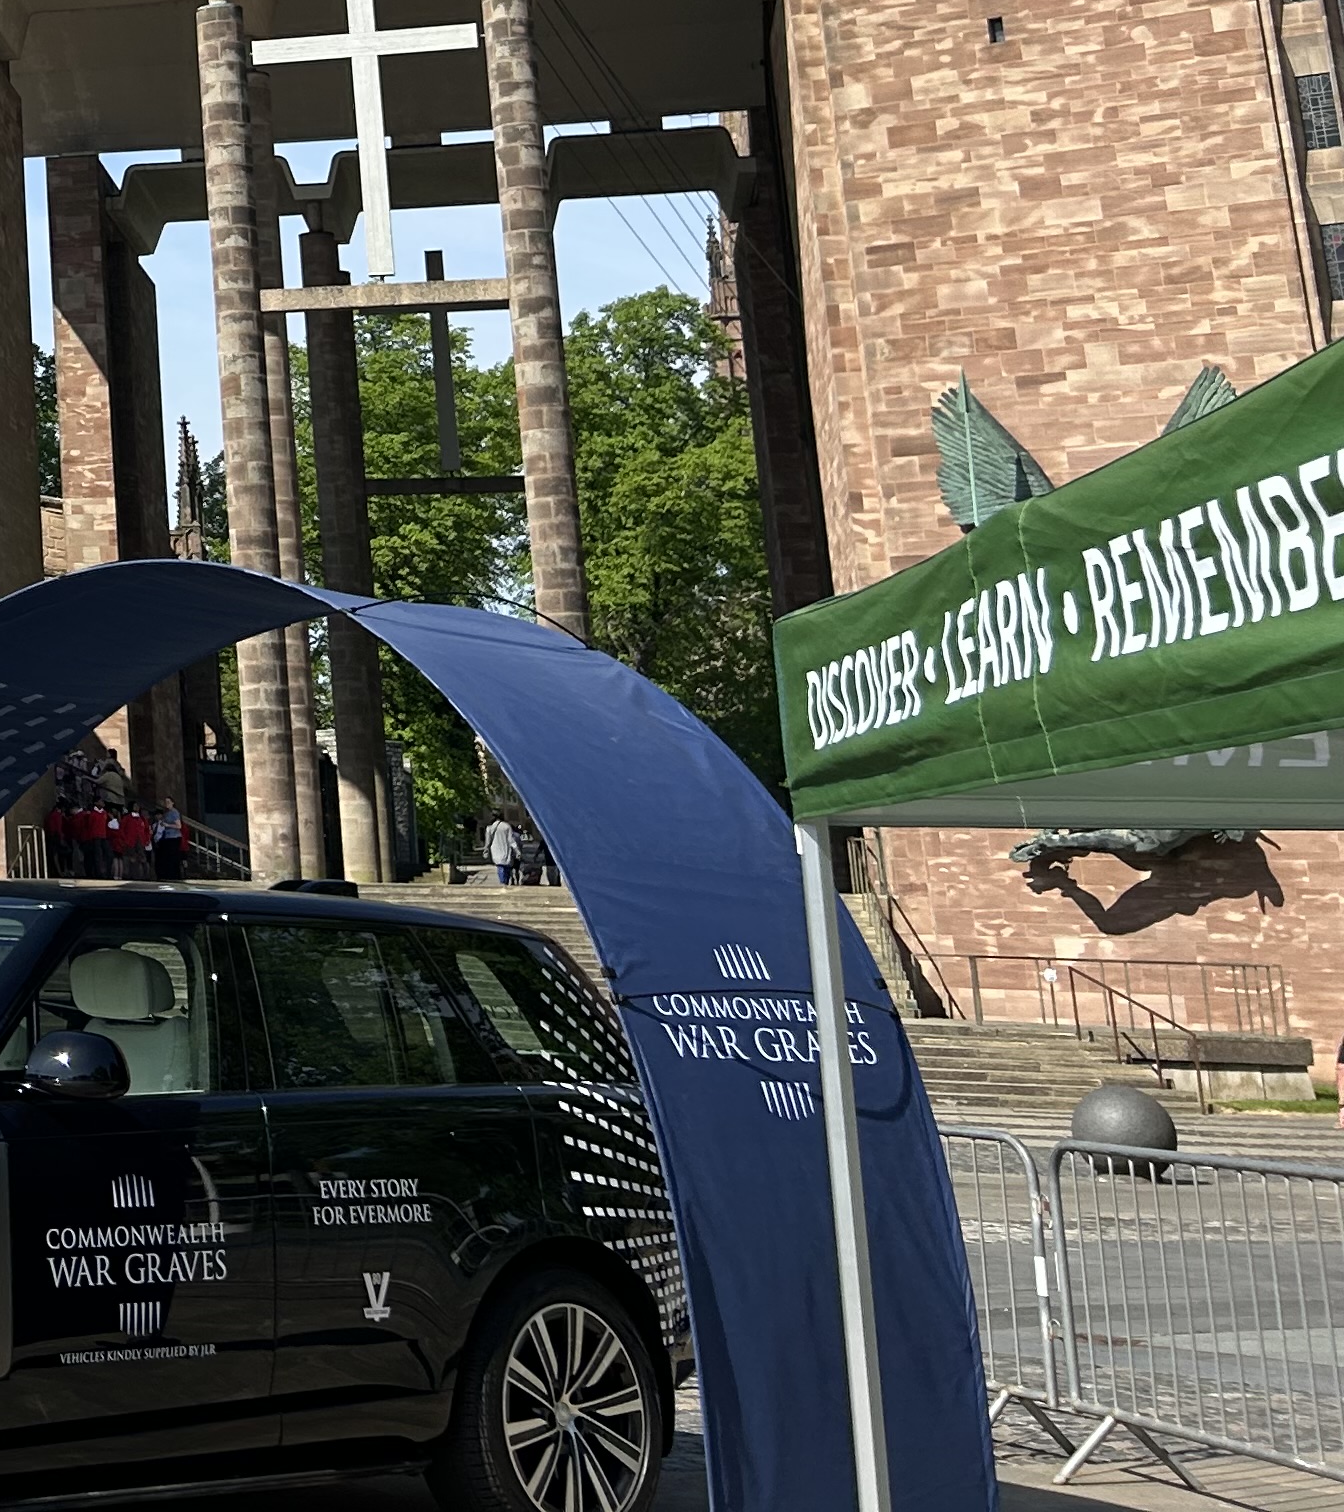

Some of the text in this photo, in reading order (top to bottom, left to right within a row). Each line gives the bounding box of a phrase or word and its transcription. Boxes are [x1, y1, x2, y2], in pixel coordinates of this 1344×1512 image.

[806, 449, 1344, 751] DISCOVER LEARN REMEMBE
[653, 994, 864, 1024] COMMONWEAH
[660, 1023, 879, 1065] WAR GRAES
[319, 1178, 420, 1200] EVERY STORY
[312, 1203, 432, 1225] FOR EVERMORE
[46, 1222, 226, 1250] COMMONWEALTH
[47, 1249, 227, 1288] WAR GRAVES
[60, 1351, 105, 1364] VEHICLES
[107, 1349, 142, 1361] KINDLY
[143, 1346, 187, 1359] SUPPLIED
[188, 1345, 200, 1356] BY
